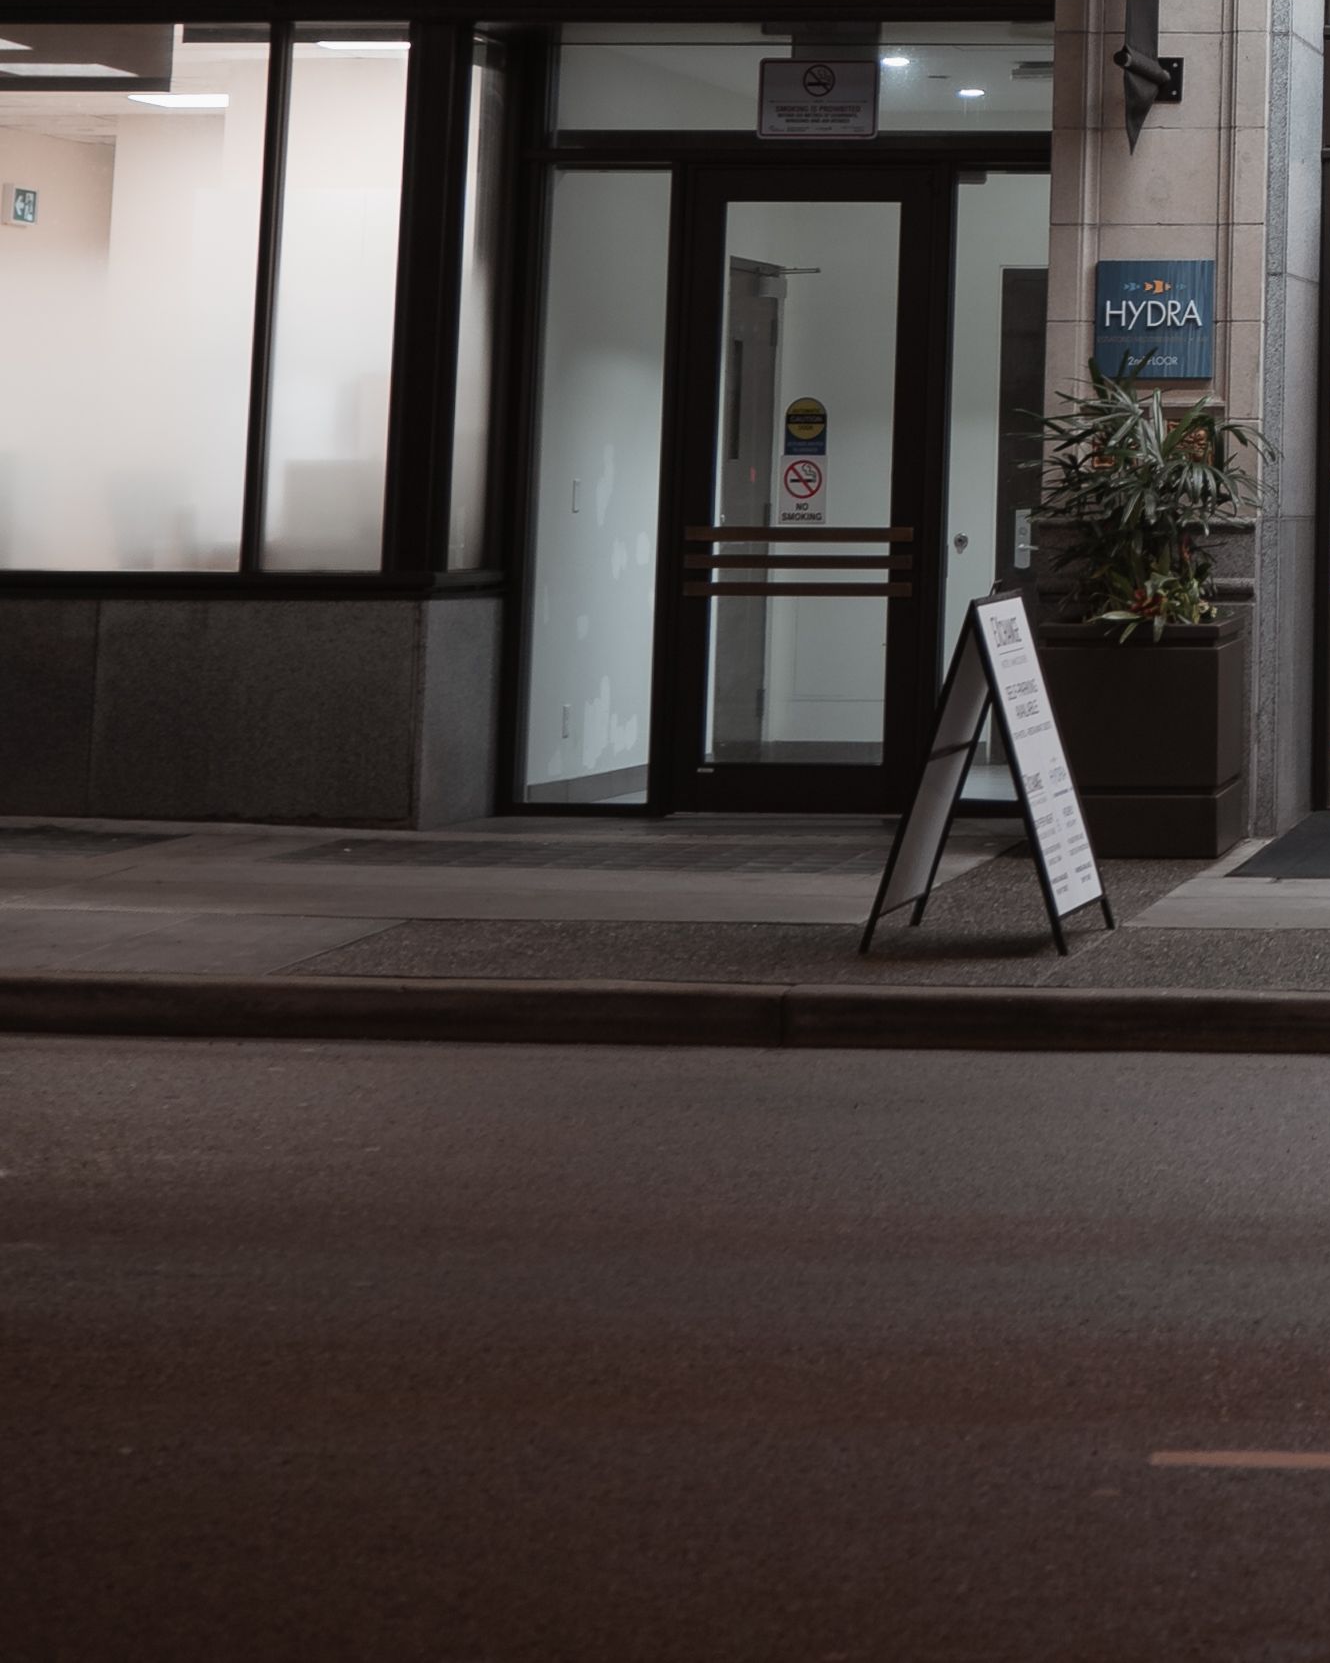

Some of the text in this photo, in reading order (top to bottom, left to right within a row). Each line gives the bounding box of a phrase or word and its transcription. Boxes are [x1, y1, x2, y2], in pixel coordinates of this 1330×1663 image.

[1105, 300, 1203, 330] HYDRA
[795, 502, 809, 511] NO
[781, 512, 823, 522] SMOKING
